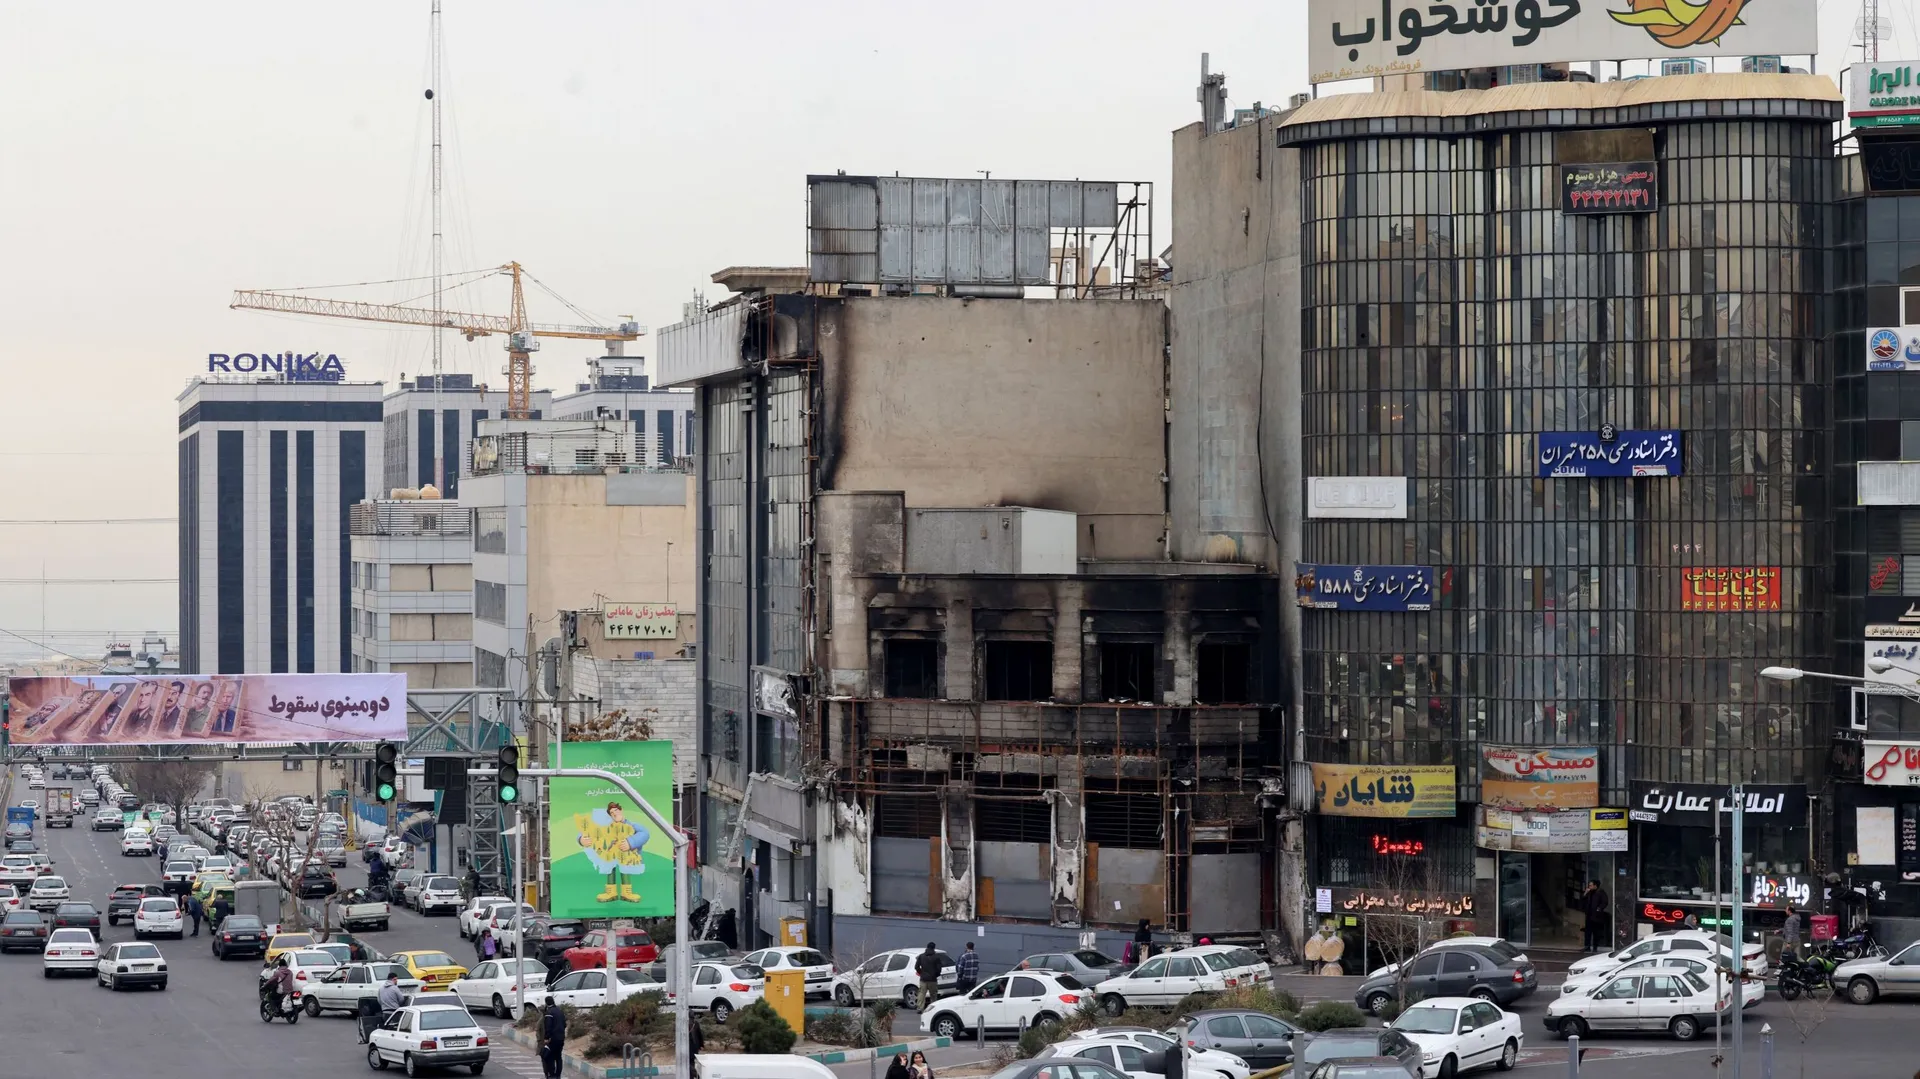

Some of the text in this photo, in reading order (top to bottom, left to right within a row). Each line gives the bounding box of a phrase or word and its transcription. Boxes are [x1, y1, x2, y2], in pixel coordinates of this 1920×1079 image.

[1385, 60, 1421, 73] فروشگاه
[1869, 66, 1910, 94] البرز
[1621, 170, 1654, 184] رسمی
[208, 353, 346, 373] RONIKA
[1541, 442, 1578, 468] تهران
[1579, 444, 1607, 460] ۲۵۸
[1609, 441, 1634, 464] رسمی
[1655, 434, 1678, 462] دفتر
[1319, 570, 1429, 603] دفتر اسناد رسمی ۱۵۸۸
[1694, 580, 1768, 600] کیانا
[607, 605, 675, 619] مطب زنان مامایی
[609, 624, 672, 636] ۴۴ ۴۲ ۷۰ ۷۰
[268, 694, 319, 720] سقوط
[320, 696, 390, 720] دومینوی
[1514, 751, 1595, 775] مسکن
[1334, 775, 1415, 807] شایان
[1643, 789, 1785, 813] املاک عمارت
[1343, 892, 1385, 910] محرابی
[1785, 876, 1810, 906] ویلا
[1406, 896, 1445, 913] شیرینی
[1452, 895, 1473, 915] نان
